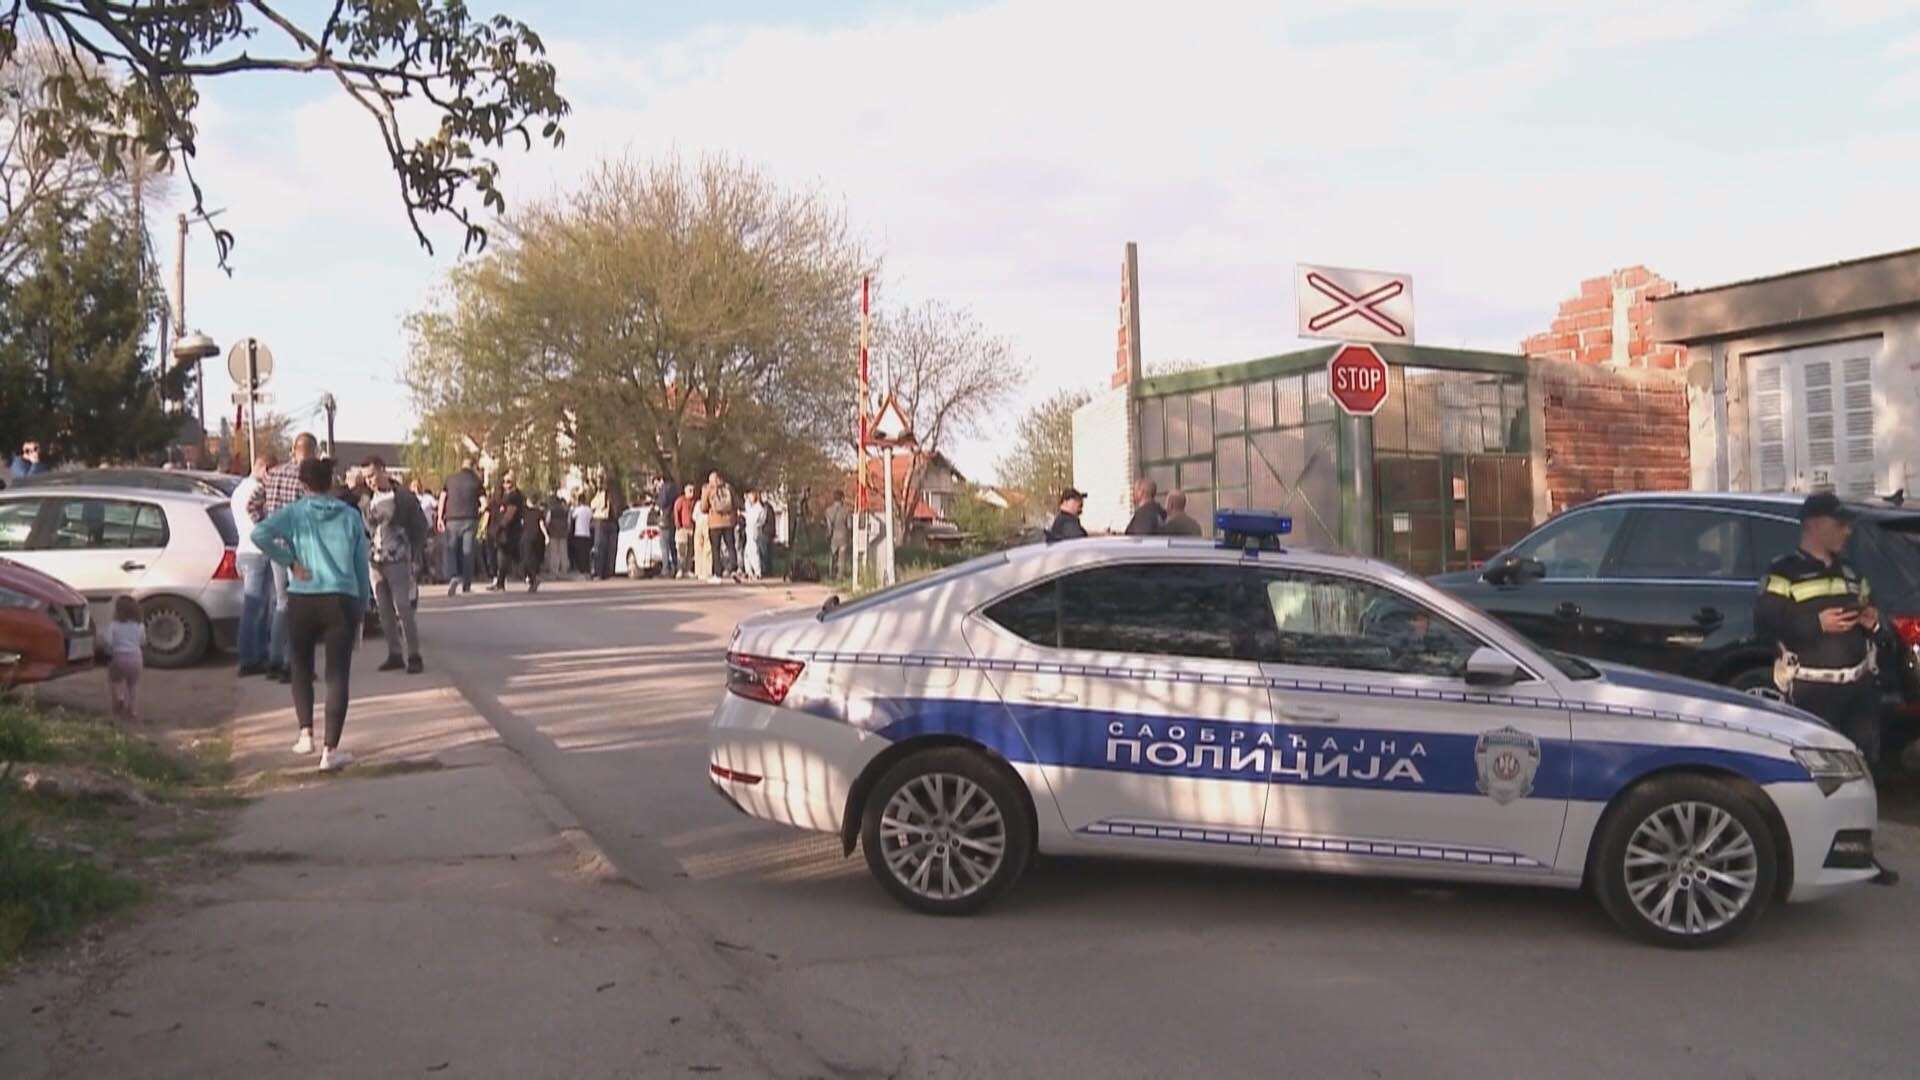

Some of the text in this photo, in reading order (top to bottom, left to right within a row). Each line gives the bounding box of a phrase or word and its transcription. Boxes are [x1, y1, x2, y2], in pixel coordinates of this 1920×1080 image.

[1337, 367, 1381, 392] STOP
[1108, 721, 1427, 757] САОБРАЋАЈНА
[1106, 737, 1424, 783] ПОЛИЦИЈА
